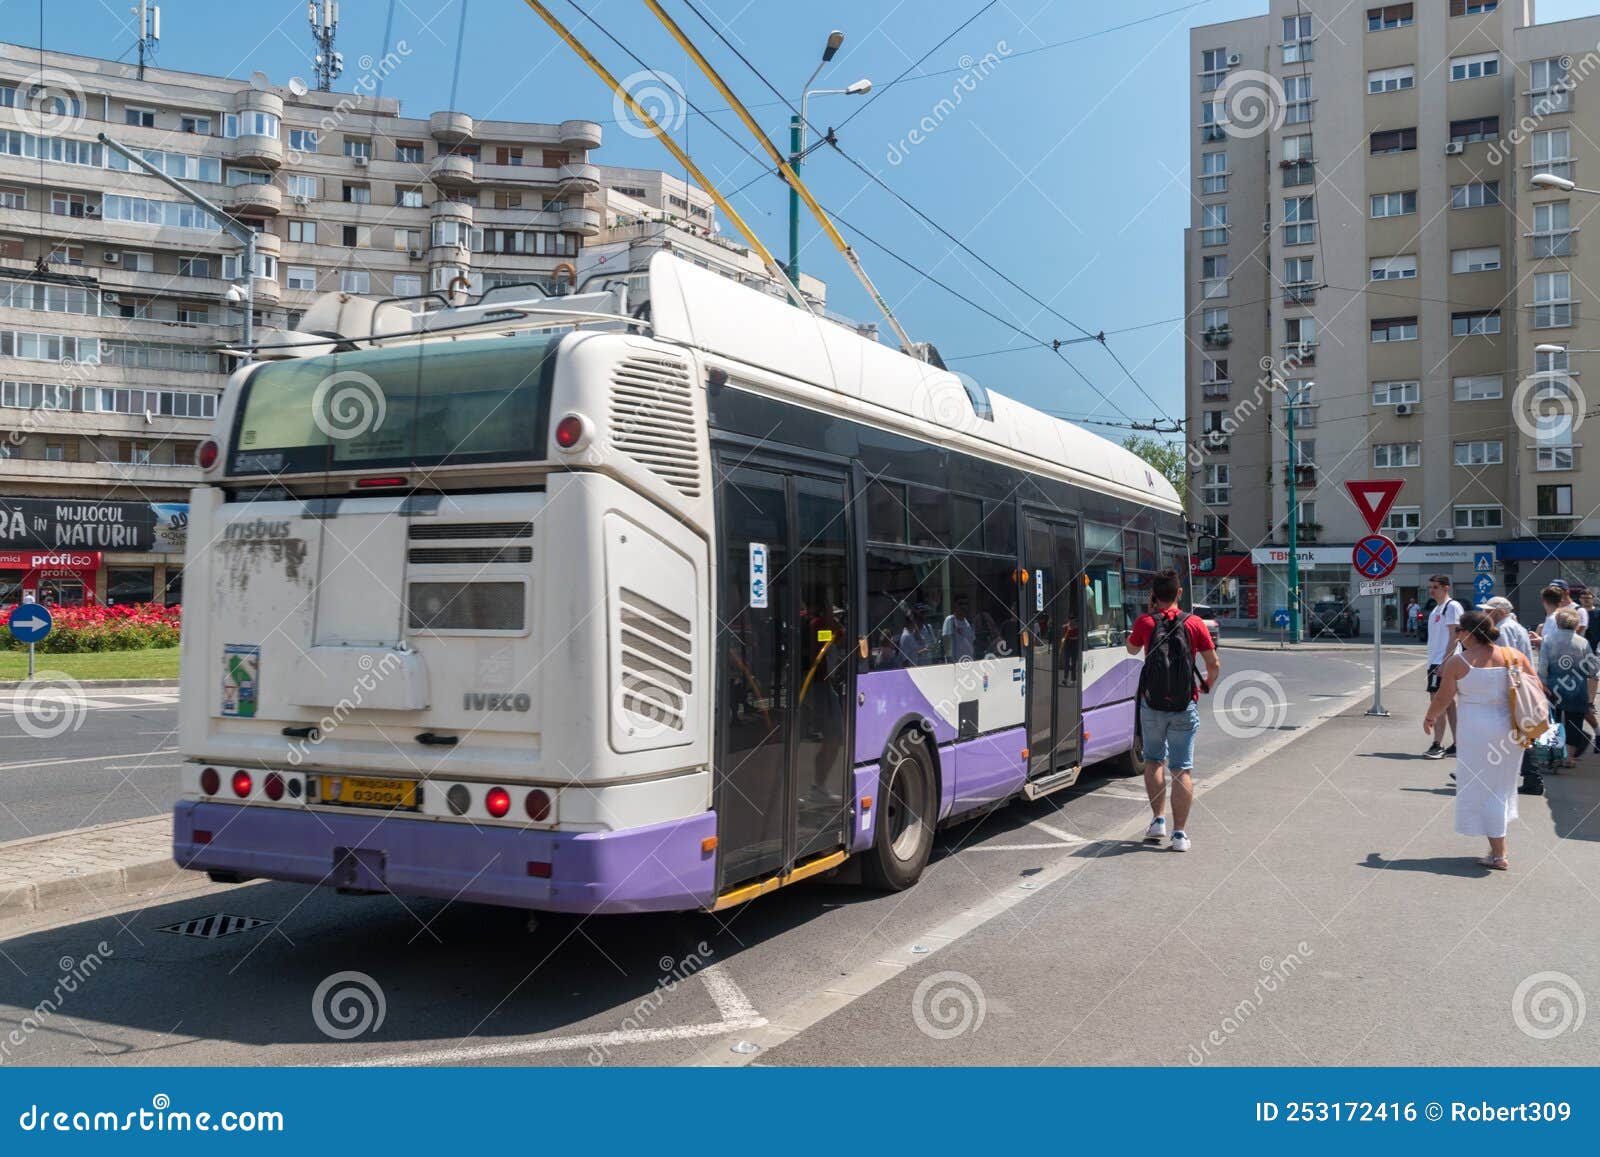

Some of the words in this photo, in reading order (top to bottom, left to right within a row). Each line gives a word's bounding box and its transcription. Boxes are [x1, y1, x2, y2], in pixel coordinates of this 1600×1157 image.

[56, 505, 124, 523] MIJLOCUL
[55, 524, 138, 547] NATURII
[463, 693, 531, 712] IVECO
